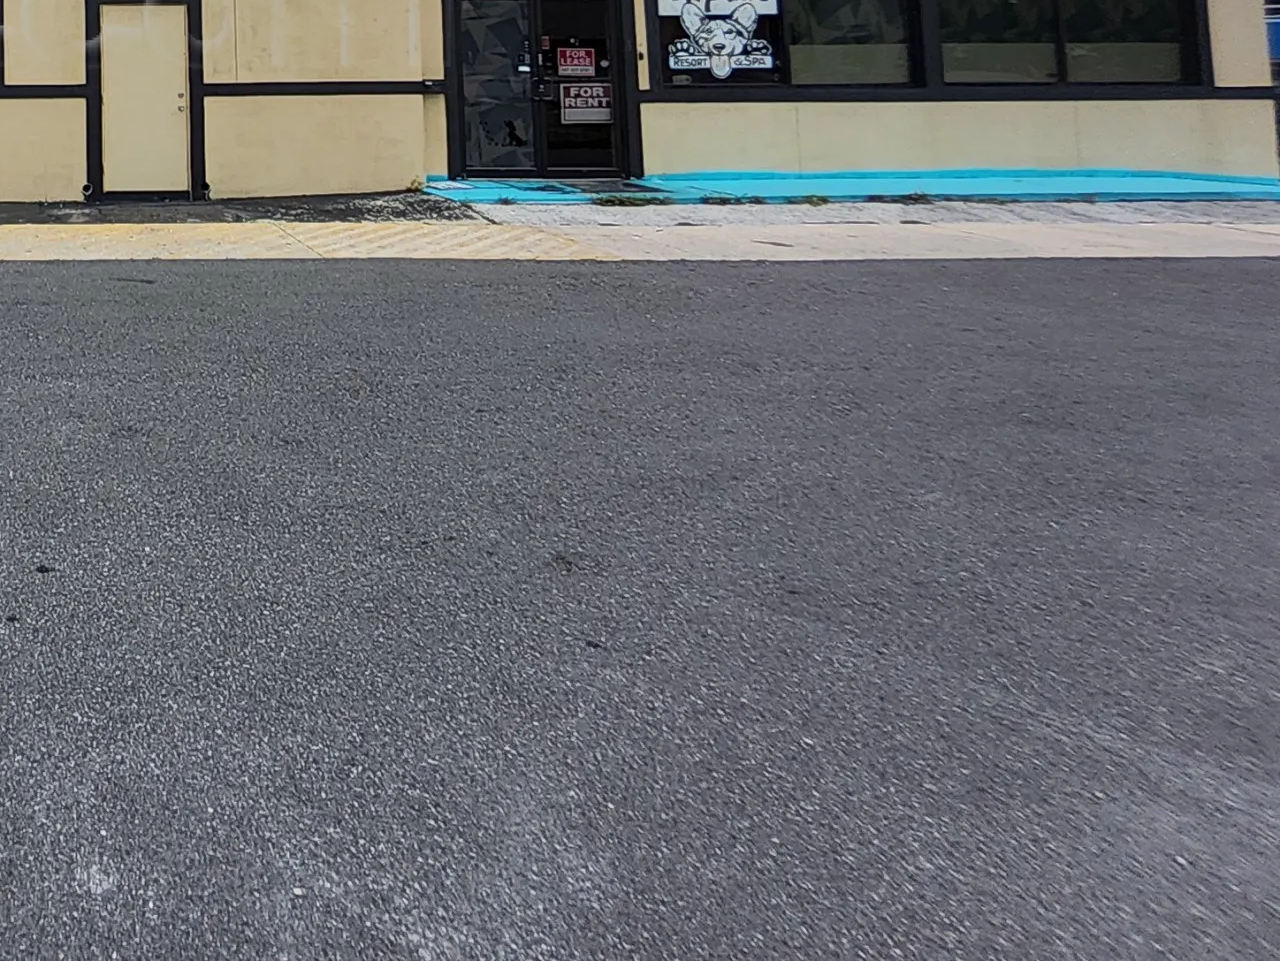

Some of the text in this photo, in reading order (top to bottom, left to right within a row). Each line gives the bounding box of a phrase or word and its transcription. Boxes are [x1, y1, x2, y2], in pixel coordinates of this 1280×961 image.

[566, 50, 586, 58] FOR
[560, 58, 591, 66] LEASE
[673, 57, 708, 67] RESORT
[569, 87, 604, 97] FOR
[565, 98, 610, 107] RENT
